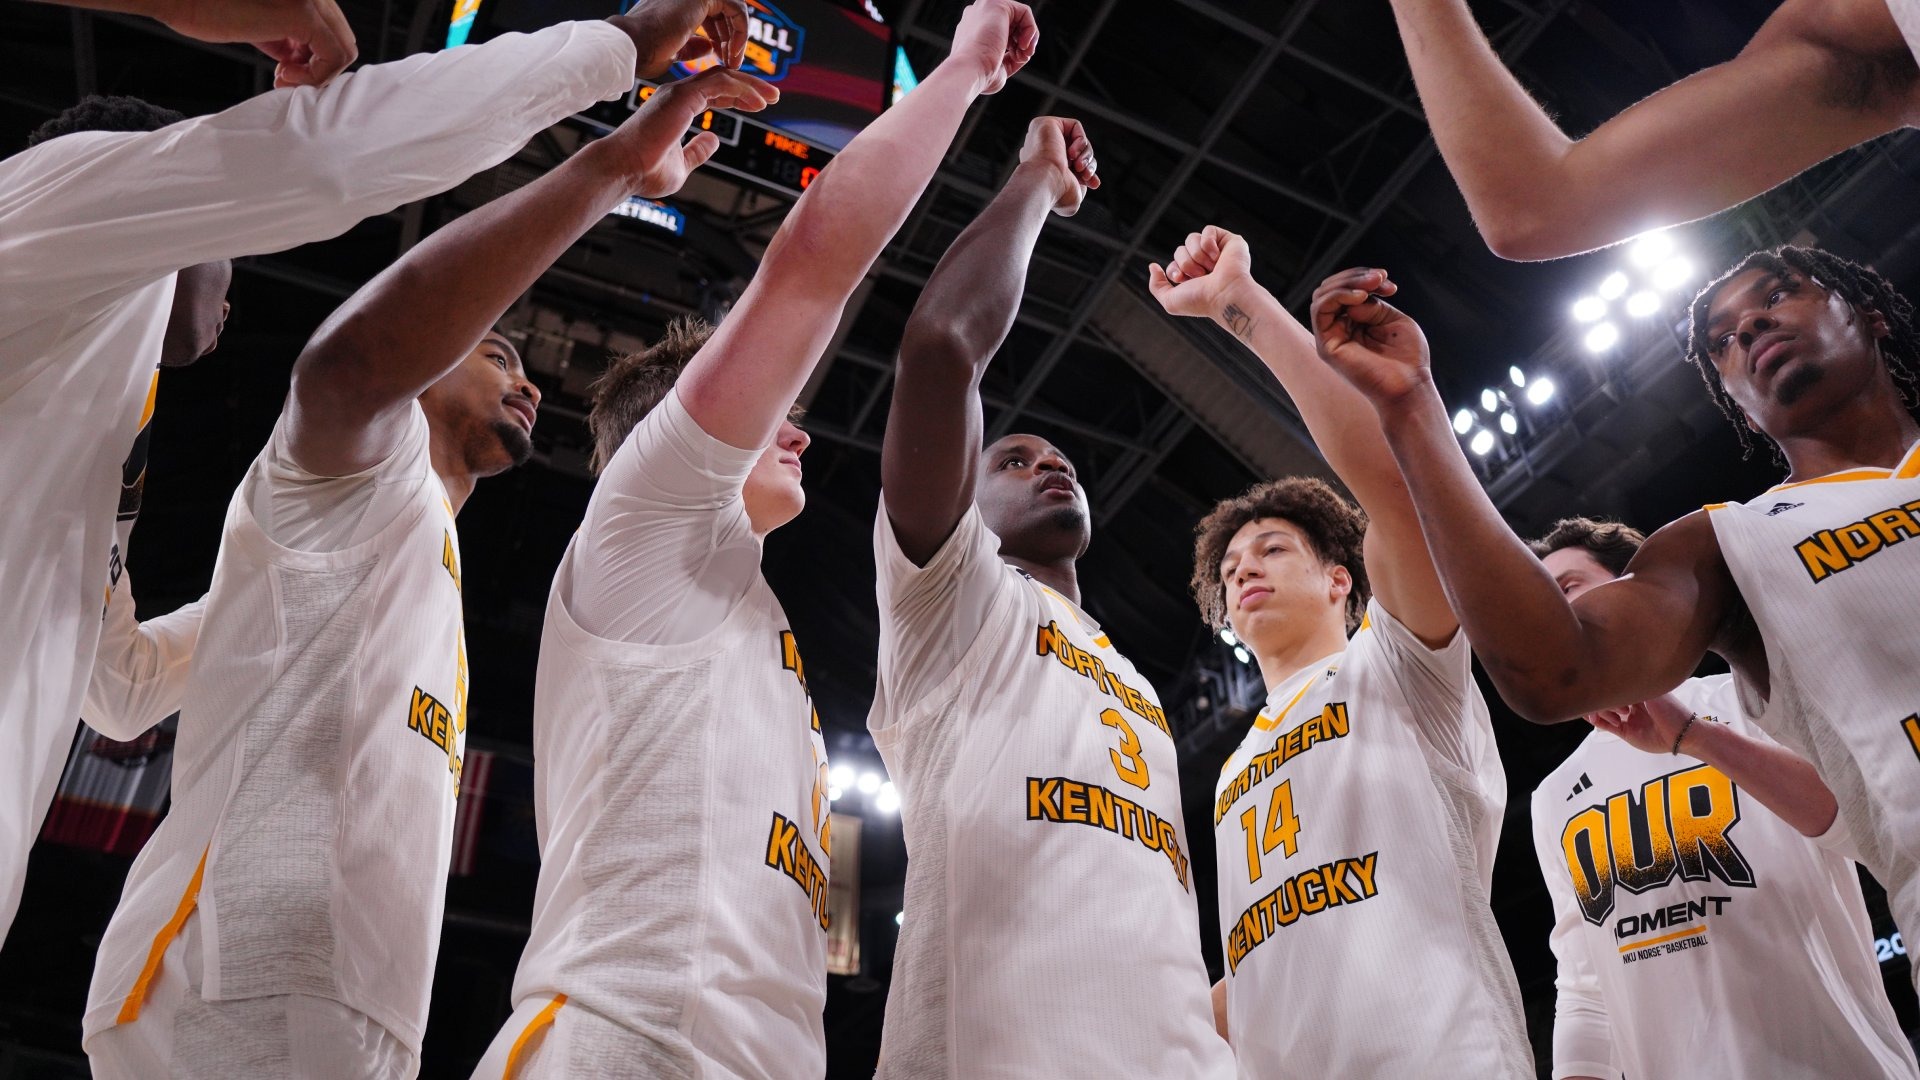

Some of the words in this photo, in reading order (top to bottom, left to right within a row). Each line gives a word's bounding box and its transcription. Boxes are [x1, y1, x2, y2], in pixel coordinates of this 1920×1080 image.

[1100, 708, 1150, 791] 3
[1215, 702, 1350, 826] NORTHERN
[1240, 778, 1301, 884] 14
[1561, 763, 1757, 927] OUR
[1227, 851, 1379, 978] KENTUCKY
[1614, 896, 1732, 946] OMENT
[1622, 951, 1637, 964] NKU
[1666, 935, 1708, 954] BASKETBALL
